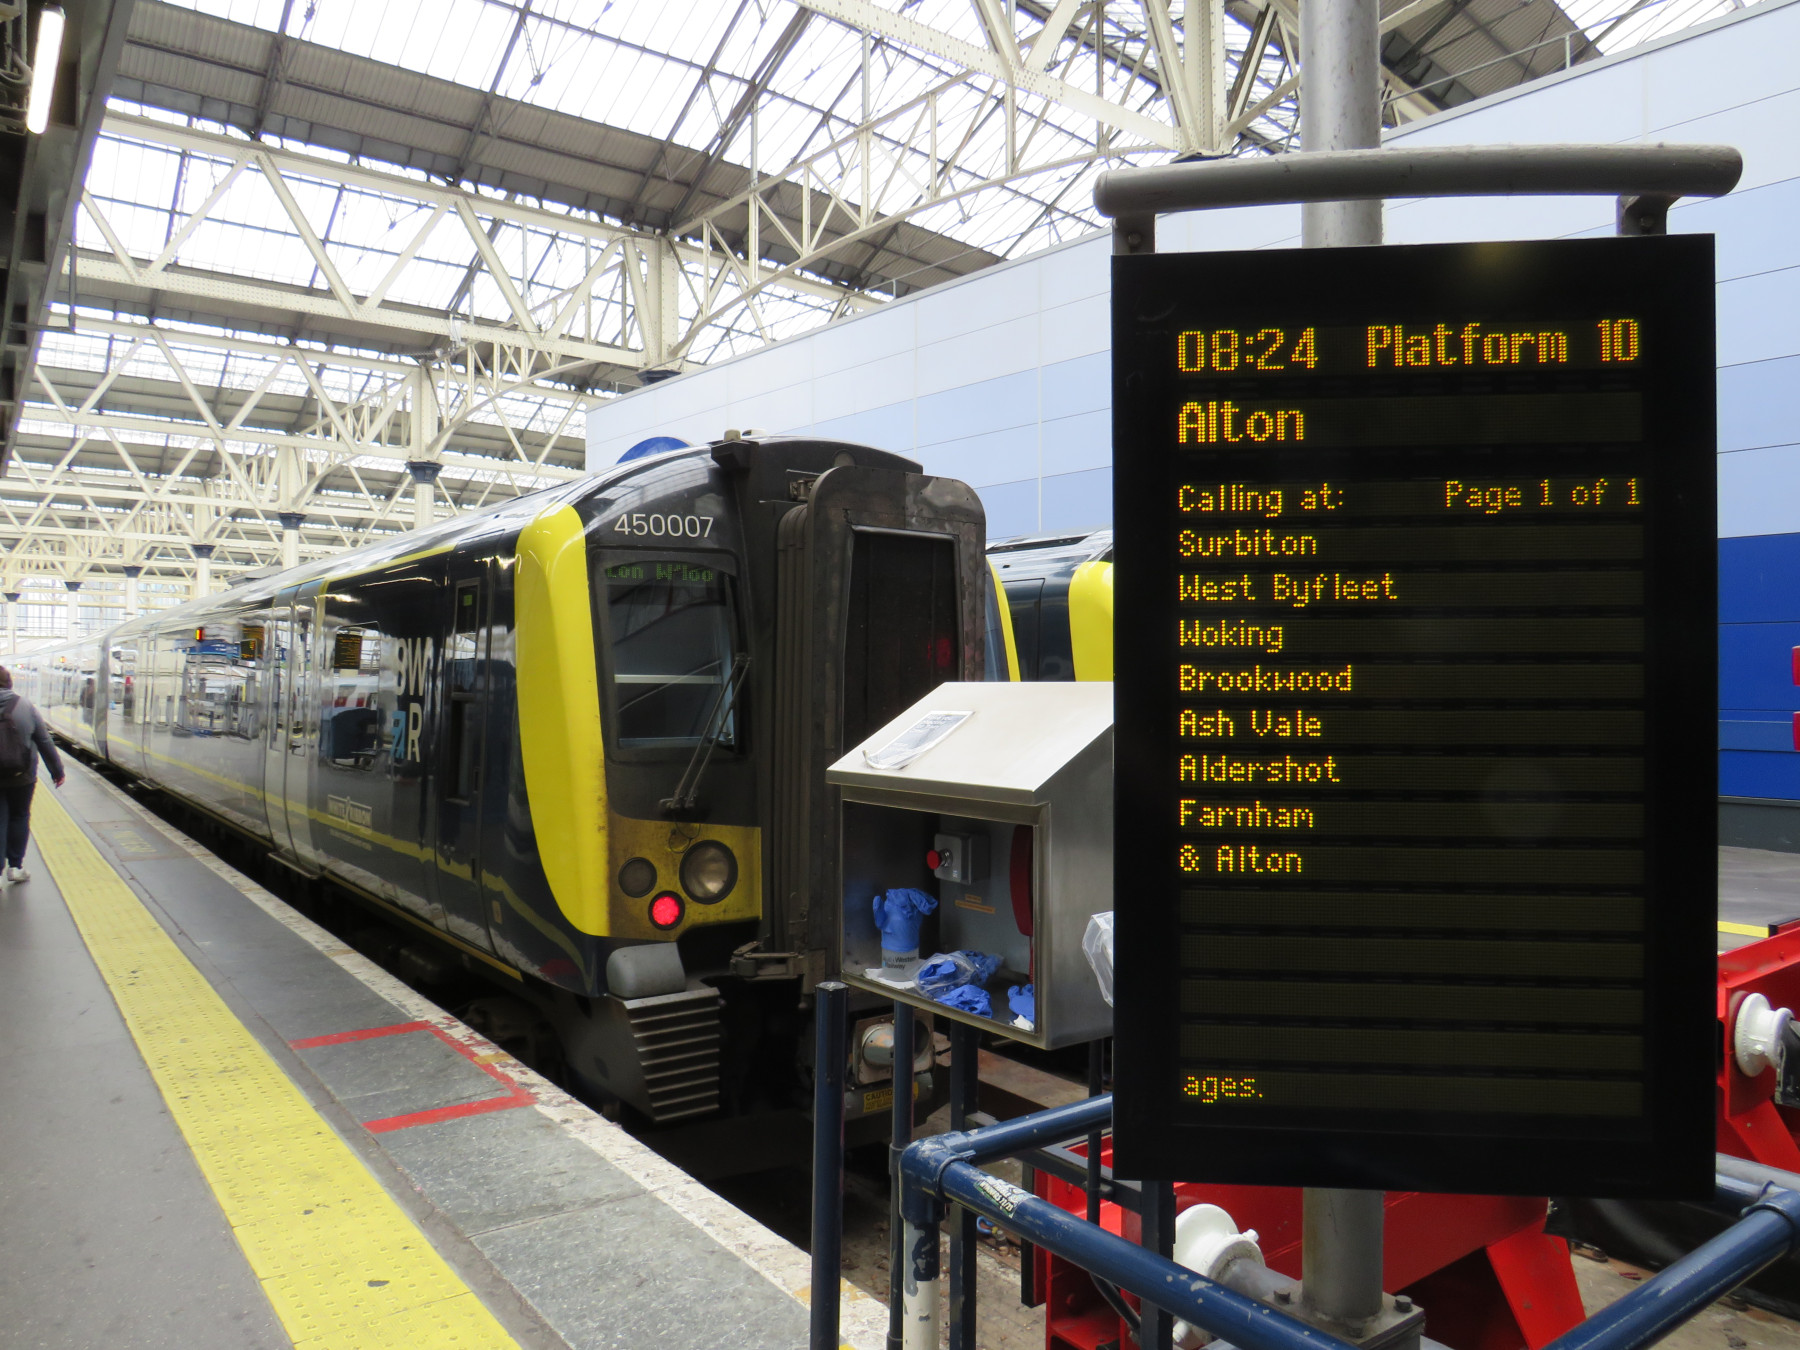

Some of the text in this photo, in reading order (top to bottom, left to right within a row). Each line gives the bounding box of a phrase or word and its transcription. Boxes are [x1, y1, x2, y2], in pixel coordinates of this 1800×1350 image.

[1177, 318, 1639, 373] 08:24 Platform 10
[1177, 400, 1304, 444] Alton
[1178, 478, 1640, 518] Calling at: Page 1 of 1
[613, 513, 714, 538] 450007
[1178, 528, 1317, 557] Surbiton
[1178, 572, 1398, 608] West Byfleet
[1179, 619, 1283, 654] Woking
[1179, 664, 1352, 692] Brookwood
[1179, 709, 1322, 737] Ash Vale
[1179, 754, 1341, 783] Aldershot
[1179, 798, 1314, 828] Farnham
[1179, 844, 1302, 873] & Alton
[1183, 1075, 1263, 1104] ages.
